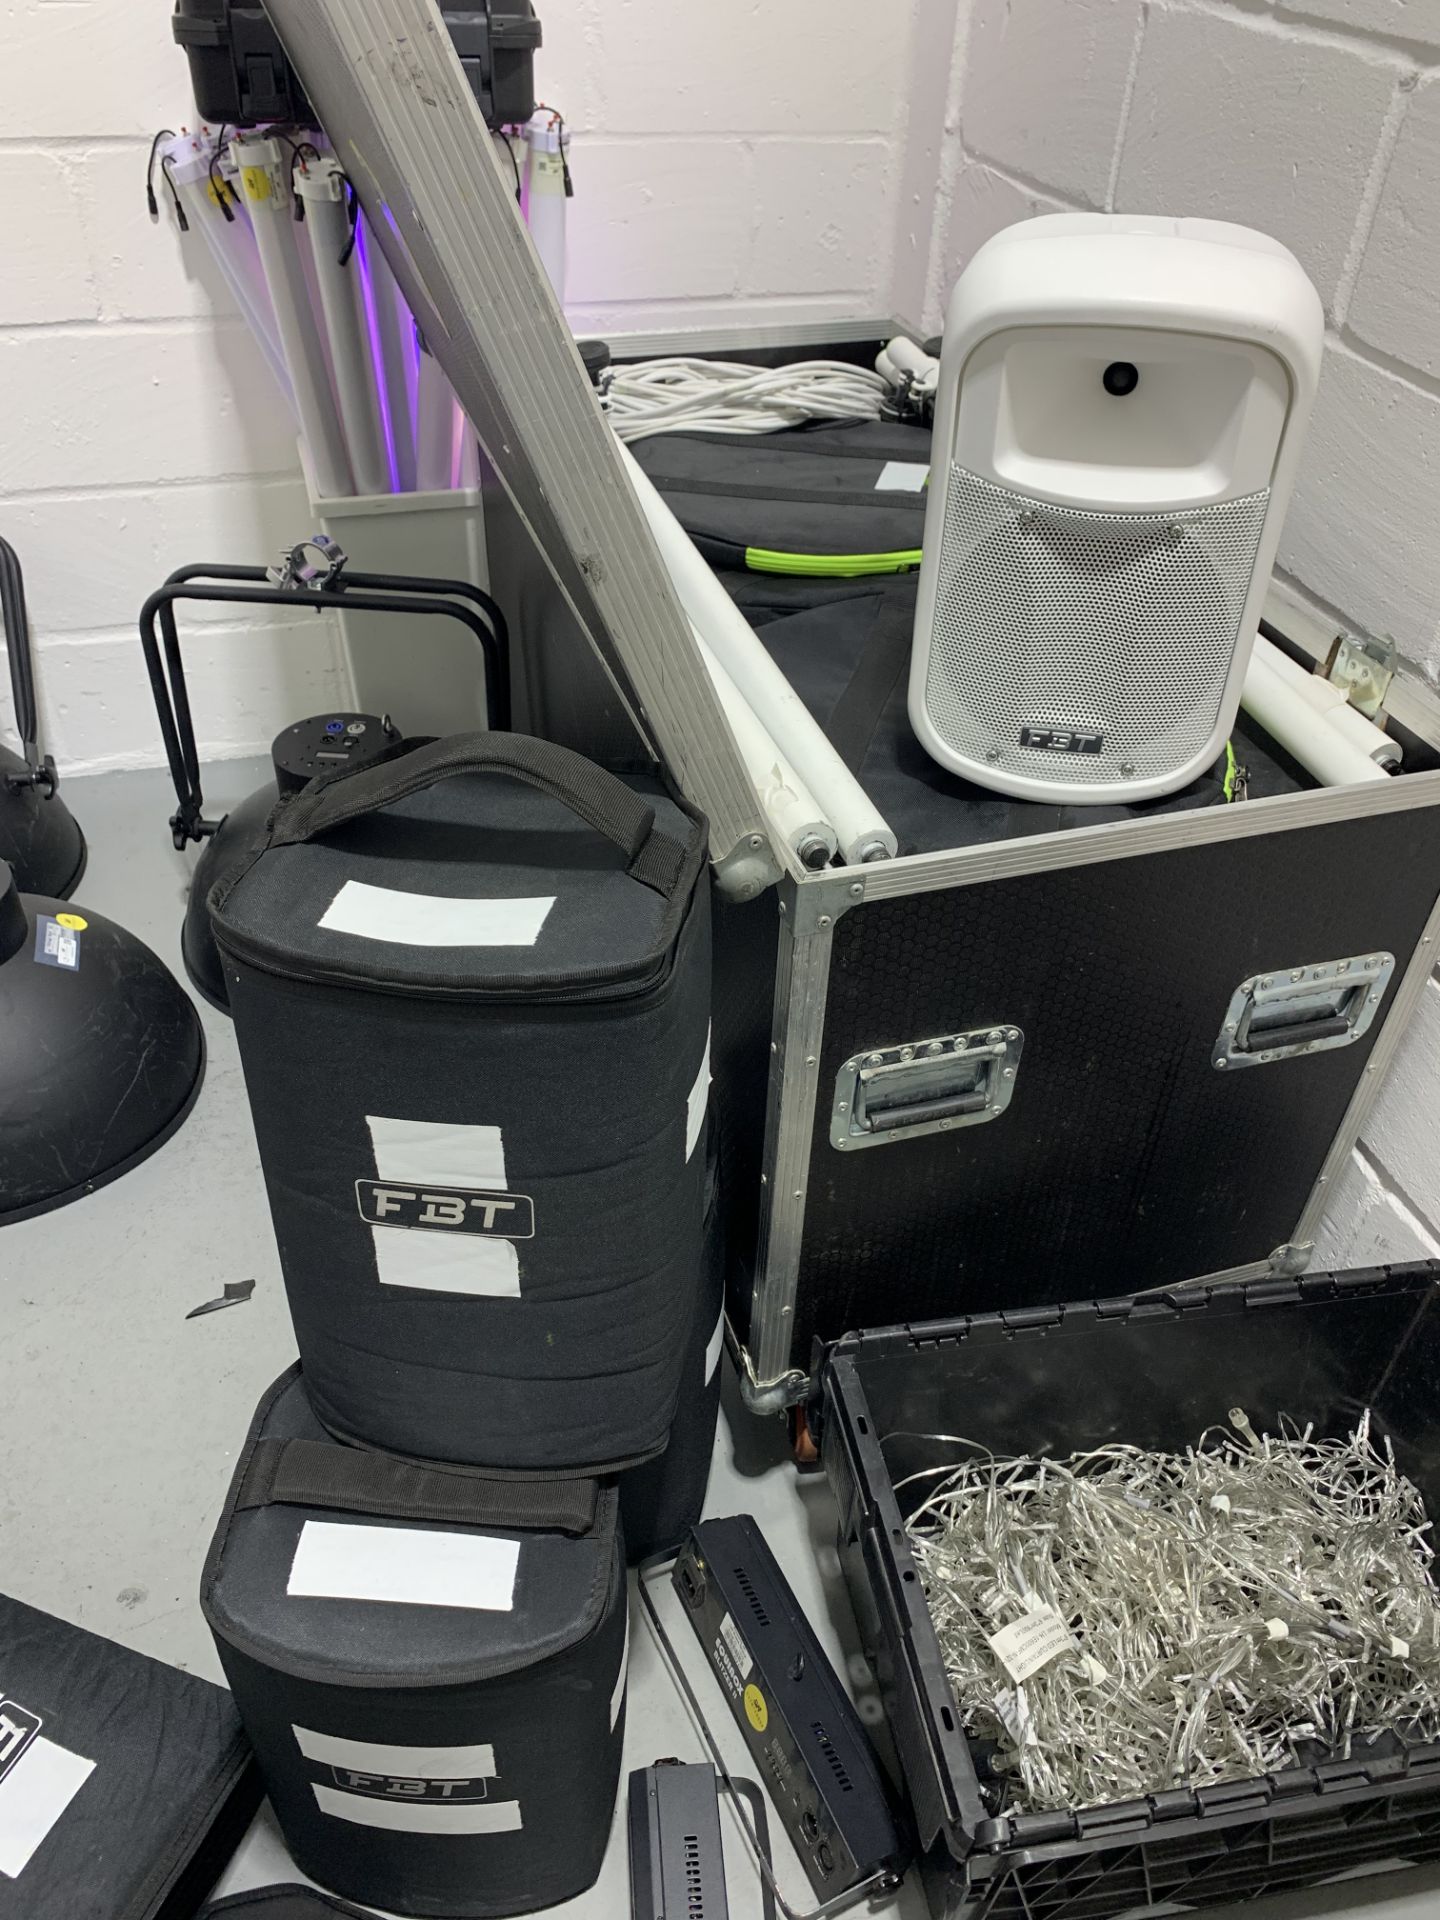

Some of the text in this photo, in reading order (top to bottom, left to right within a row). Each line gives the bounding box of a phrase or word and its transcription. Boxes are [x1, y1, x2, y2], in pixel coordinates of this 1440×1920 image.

[1027, 729, 1097, 751] FBT
[372, 1188, 515, 1228] FBT
[713, 1649, 734, 1692] BLITZER
[346, 1771, 470, 1797] FBT
